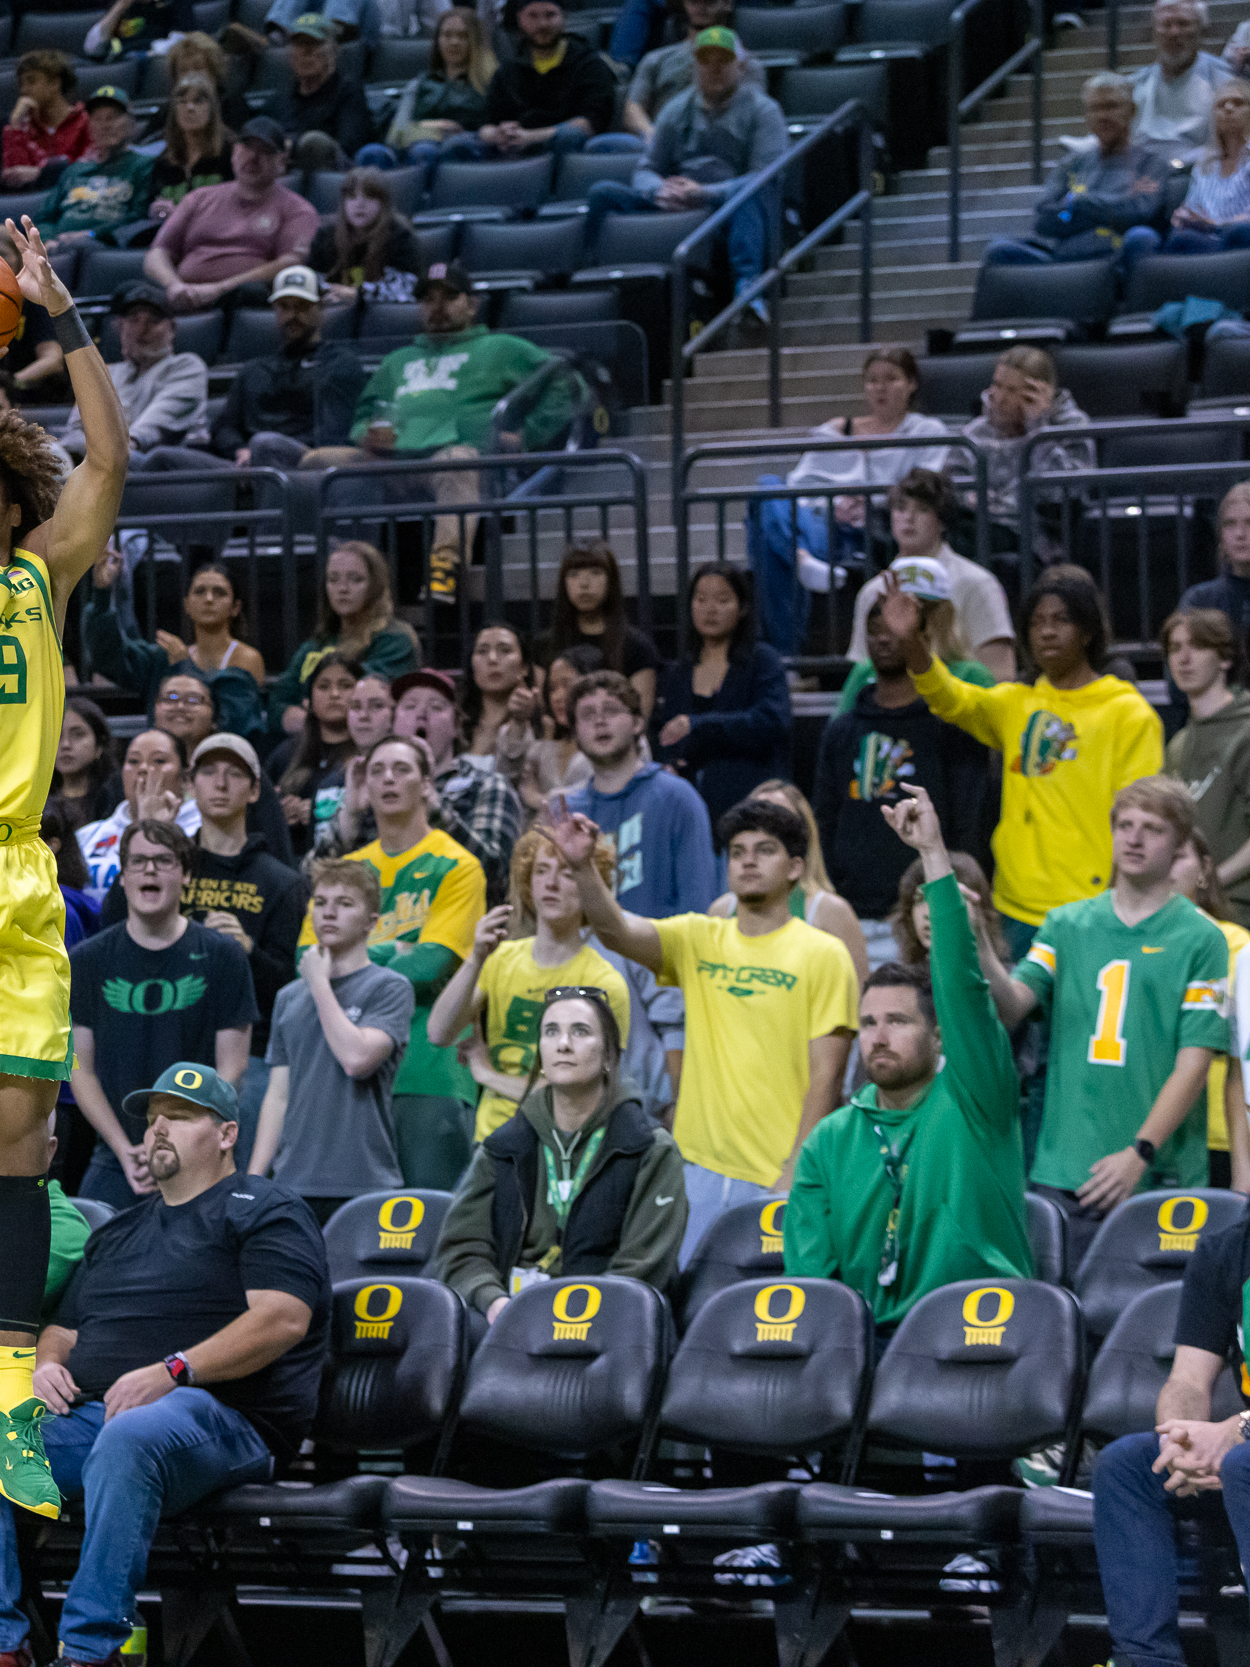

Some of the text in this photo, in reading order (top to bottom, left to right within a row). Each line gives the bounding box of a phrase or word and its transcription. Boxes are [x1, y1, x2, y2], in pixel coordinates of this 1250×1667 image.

[131, 978, 175, 1015] O
[1087, 959, 1131, 1068] 1
[174, 1069, 203, 1090] O
[378, 1196, 425, 1232] O
[1157, 1196, 1210, 1234] O
[354, 1284, 403, 1321] O
[552, 1284, 602, 1322] O
[754, 1284, 806, 1323] O
[962, 1287, 1015, 1327] O
